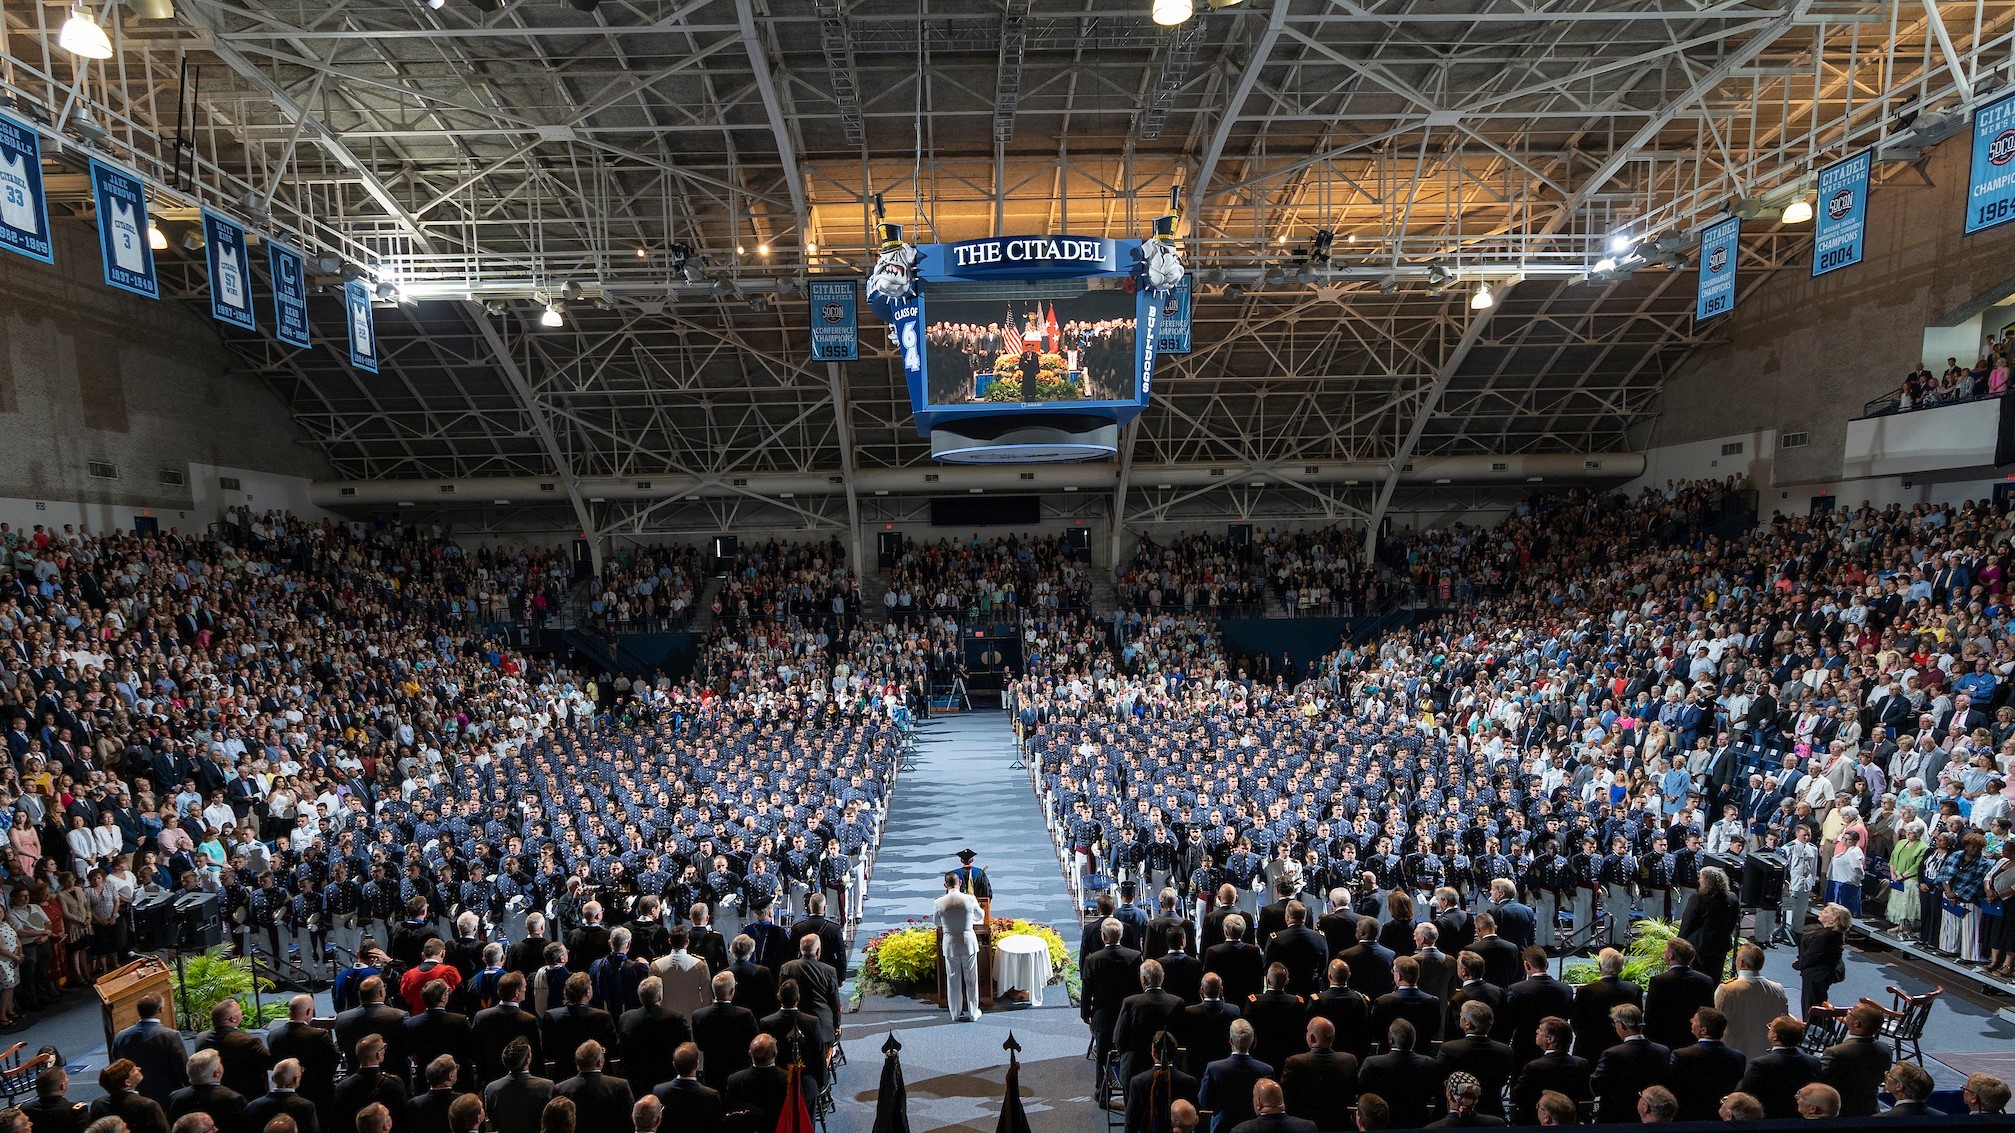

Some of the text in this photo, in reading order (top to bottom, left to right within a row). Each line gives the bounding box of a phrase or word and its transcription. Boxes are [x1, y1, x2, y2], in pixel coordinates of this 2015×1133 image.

[1981, 118, 2008, 137] MEN'S
[1989, 135, 2015, 161] SOCO
[110, 174, 128, 190] JAKE
[1822, 158, 1866, 187] CITADEL
[103, 181, 137, 203] BURROWS
[1821, 172, 1866, 195] WRESTLING
[6, 184, 24, 207] 33
[123, 233, 131, 249] 3
[1704, 221, 1737, 243] CITADEL
[1704, 233, 1736, 250] WRESTLING
[1818, 230, 1858, 252] CHAMPIONS
[953, 240, 1107, 266] THE CITADEL
[1821, 244, 1853, 270] 2004
[280, 253, 295, 285] C
[225, 272, 236, 289] 57
[812, 285, 853, 294] CITADEL
[1701, 272, 1732, 289] TOURNAMENT
[1701, 281, 1731, 298] CHAMPIONS
[894, 307, 919, 321] CLASS OF
[1704, 295, 1726, 315] 1967
[816, 334, 854, 342] CHAMPIONS
[1159, 327, 1187, 335] AMPIONS
[821, 346, 848, 357] 1959
[1142, 305, 1157, 394] BULLDOGS
